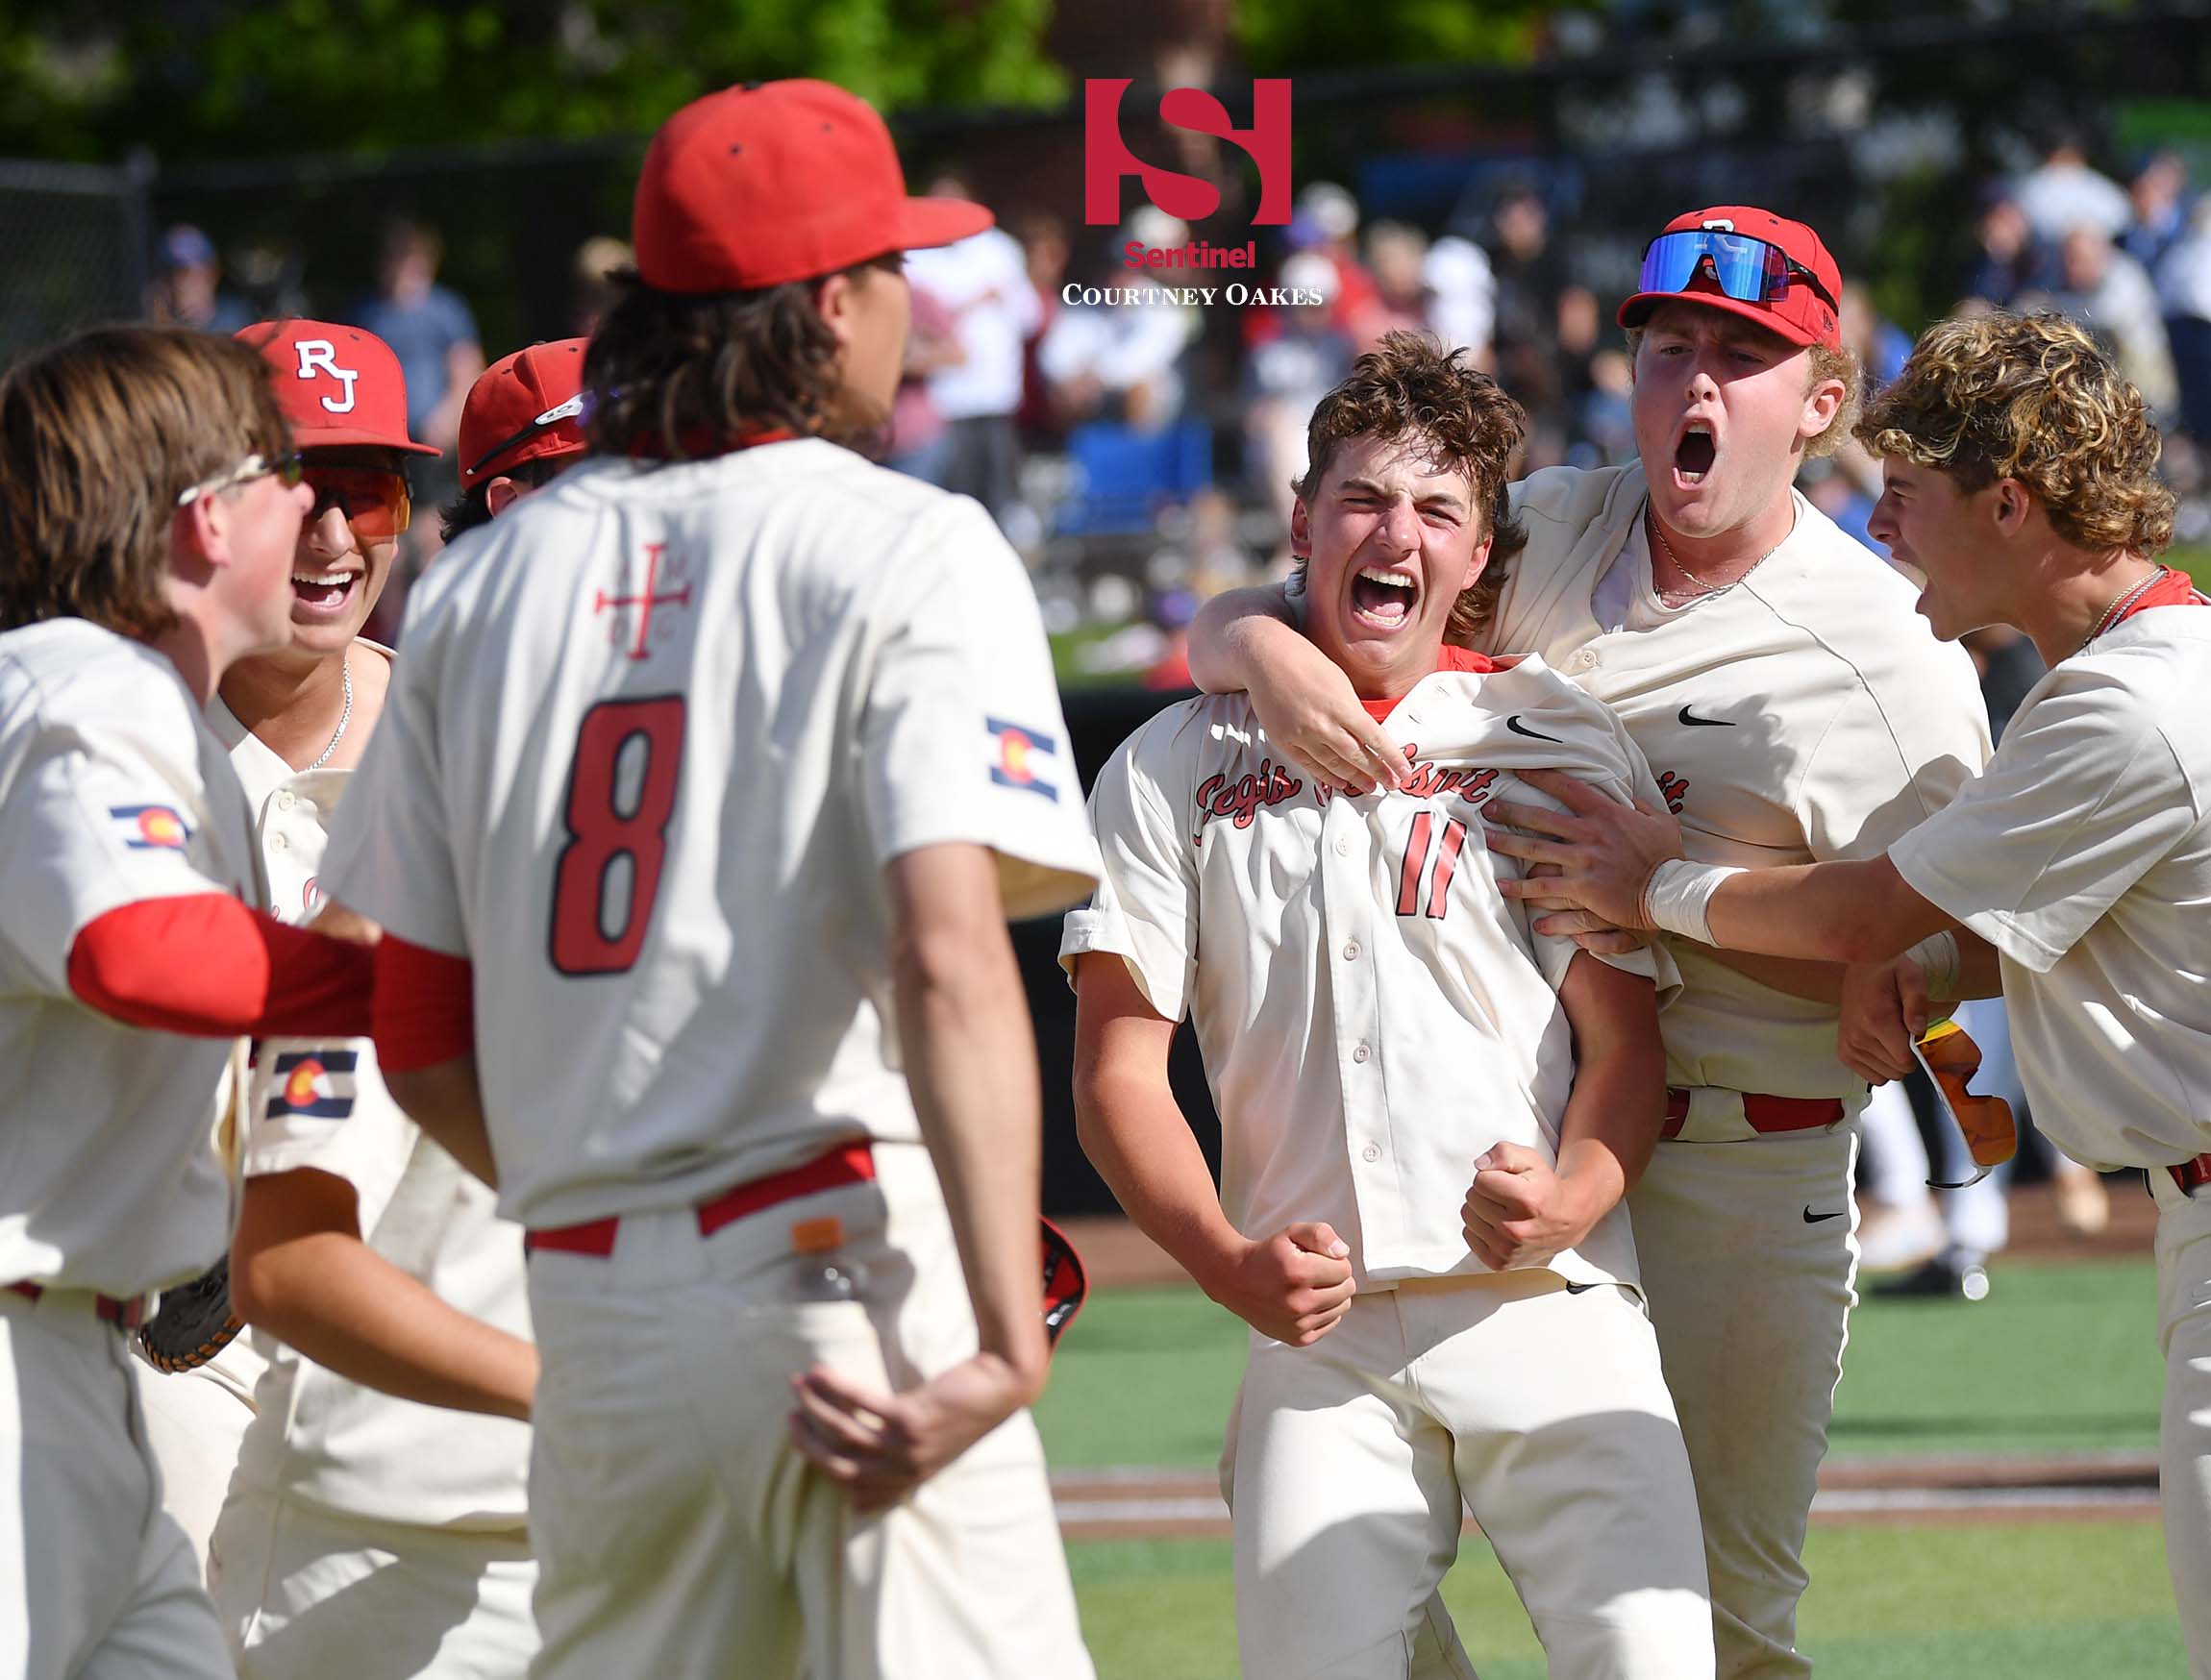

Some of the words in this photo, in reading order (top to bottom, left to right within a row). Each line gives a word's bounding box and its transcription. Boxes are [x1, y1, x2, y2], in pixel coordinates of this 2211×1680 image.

[294, 339, 358, 413] RJ
[550, 695, 686, 976] 8
[1395, 810, 1468, 921] 11
